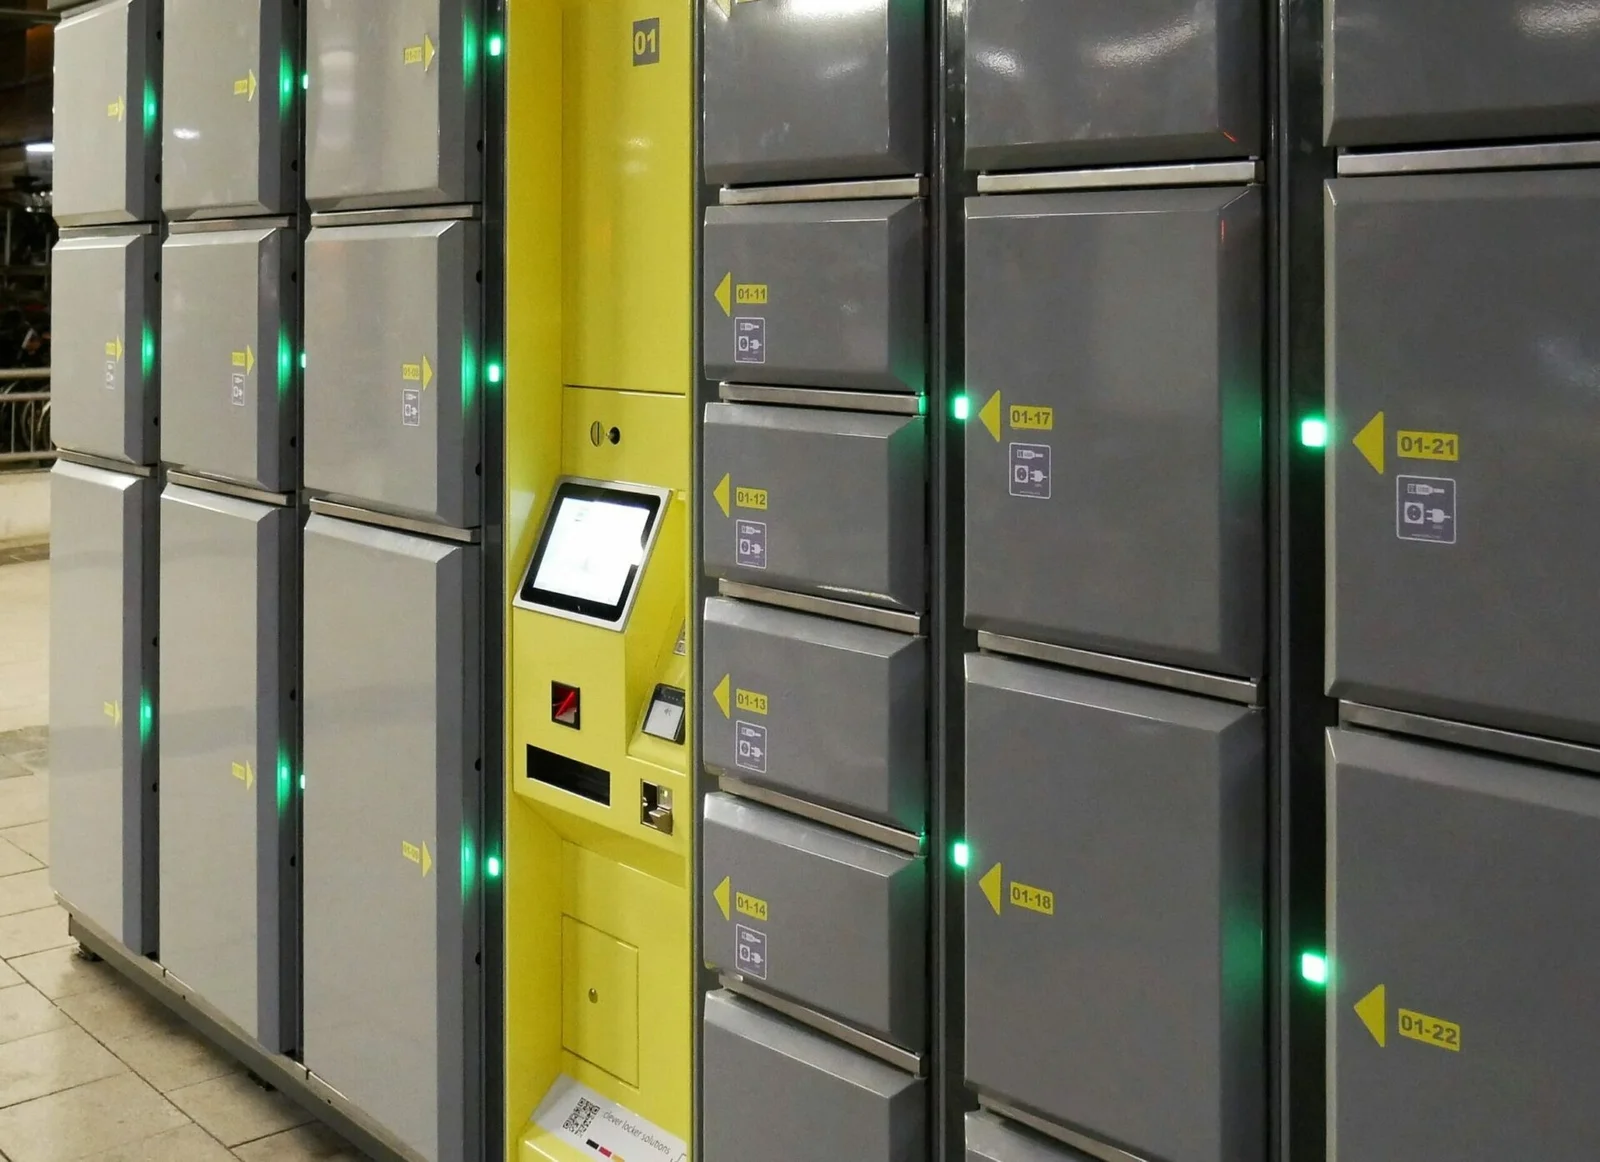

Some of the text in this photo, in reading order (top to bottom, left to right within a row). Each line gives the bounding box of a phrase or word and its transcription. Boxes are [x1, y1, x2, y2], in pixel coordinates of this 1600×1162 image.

[634, 29, 656, 55] 01
[738, 288, 766, 300] 01-11
[1012, 410, 1051, 425] 01-17
[1400, 436, 1455, 455] 01-21
[738, 491, 766, 505] 01-12
[738, 693, 766, 710] 01-13
[738, 897, 766, 916] 01-14
[1012, 887, 1051, 909] 01-18
[1401, 1015, 1457, 1045] 01-22
[603, 1111, 671, 1155] clever locker solutions
